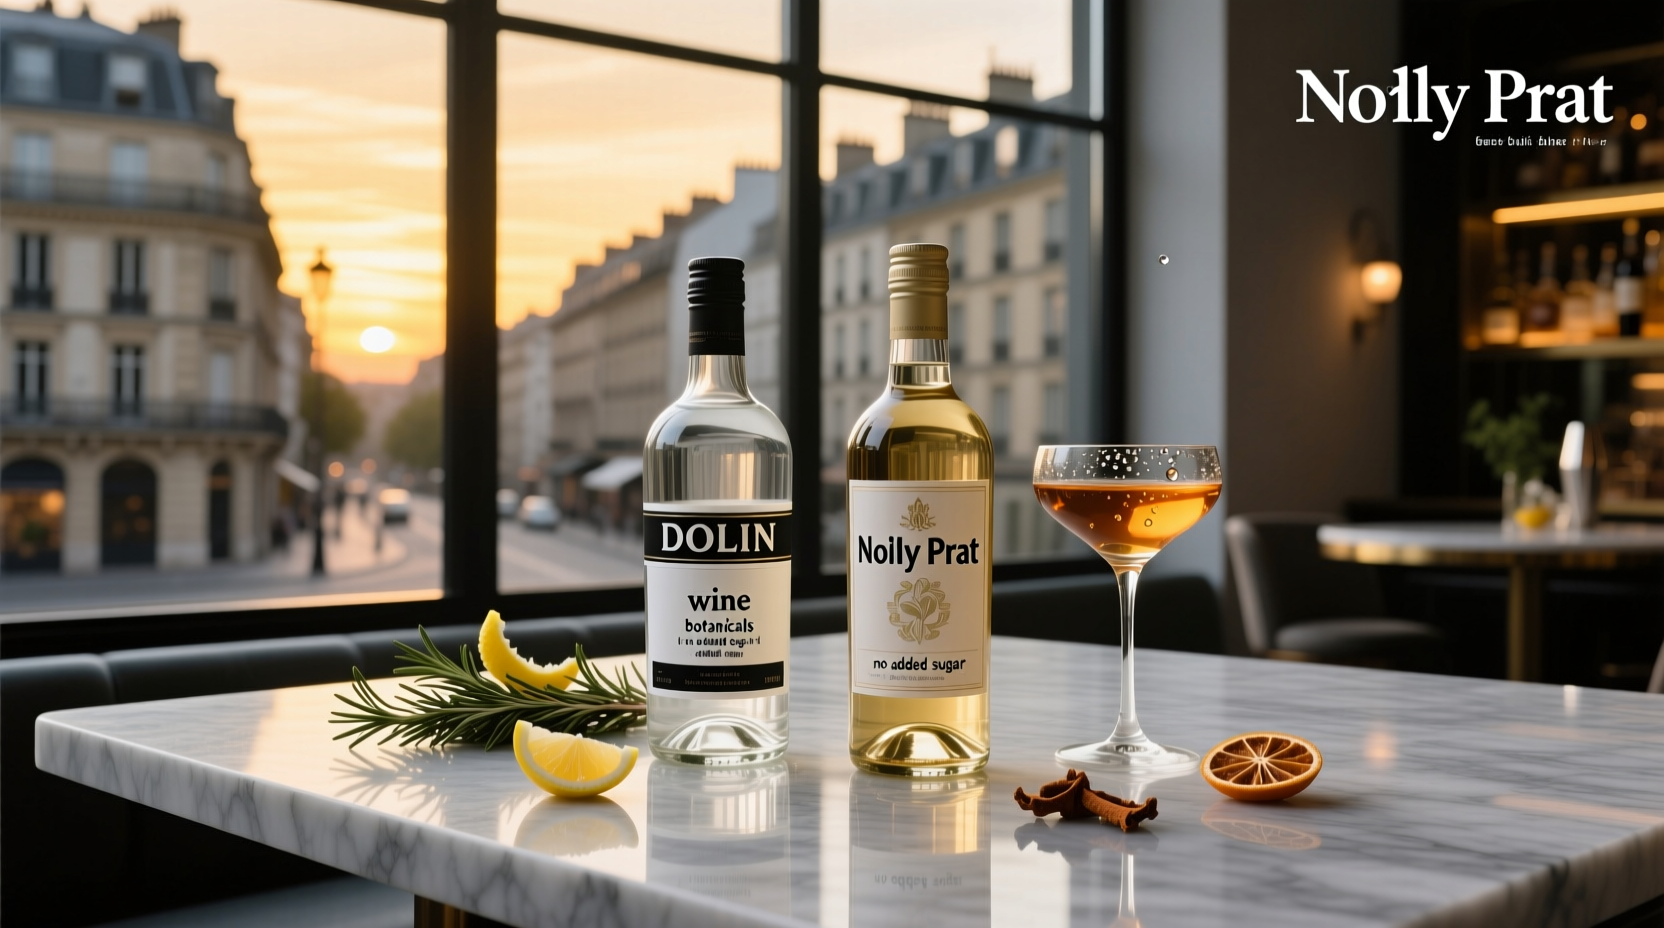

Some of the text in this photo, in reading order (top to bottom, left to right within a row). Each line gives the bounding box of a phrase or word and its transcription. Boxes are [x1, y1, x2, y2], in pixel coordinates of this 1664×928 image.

[661, 522, 777, 553] DOLIN
[927, 537, 980, 565] Prat
[687, 586, 751, 612] wine
[685, 617, 754, 634] botanicals
[873, 656, 967, 674] no added sugar
